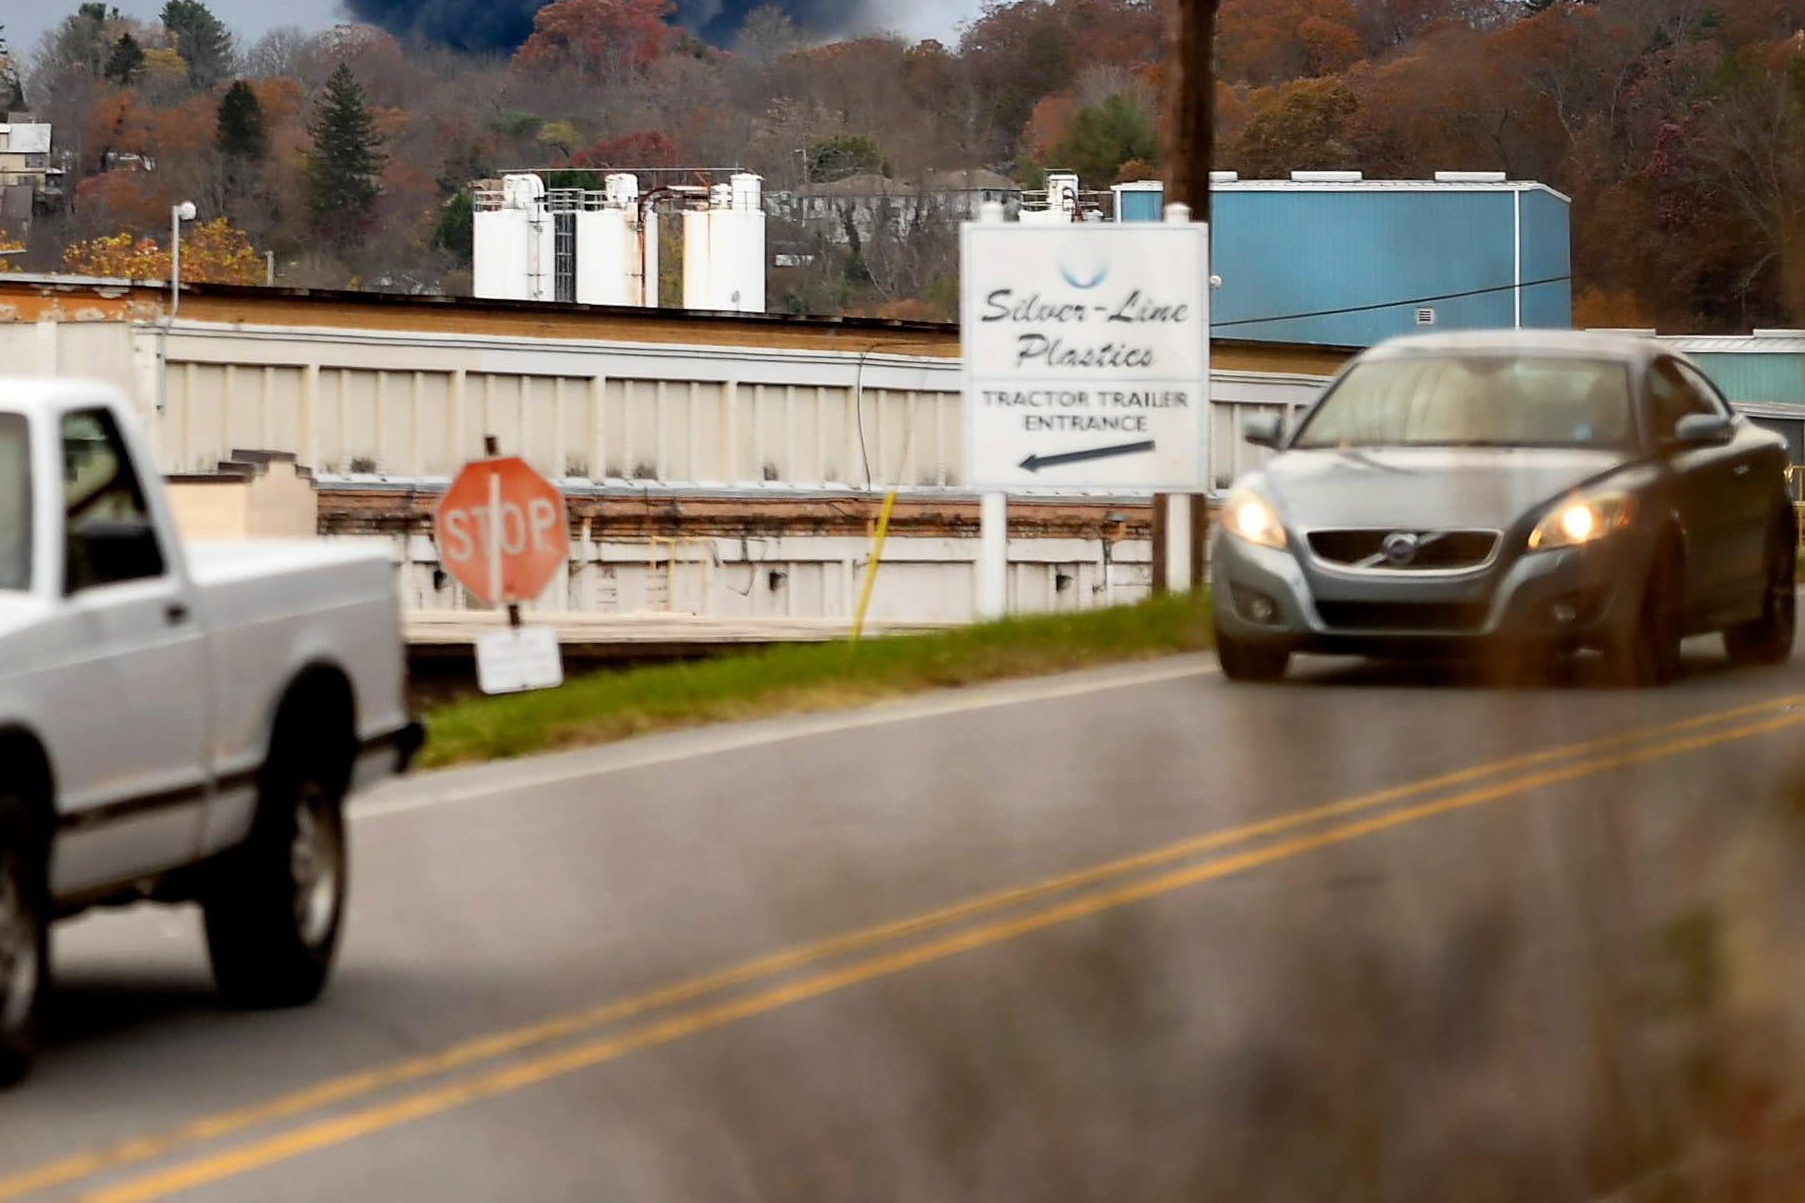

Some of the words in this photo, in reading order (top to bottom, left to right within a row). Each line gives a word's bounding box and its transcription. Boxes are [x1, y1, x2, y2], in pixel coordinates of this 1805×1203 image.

[981, 288, 1191, 324] Silver-Line
[1015, 332, 1157, 368] Plastics
[982, 390, 1089, 408] TRACTOR
[1097, 390, 1189, 409] TRAILER
[1022, 414, 1149, 433] ENTRANCE
[445, 496, 557, 563] STOP
